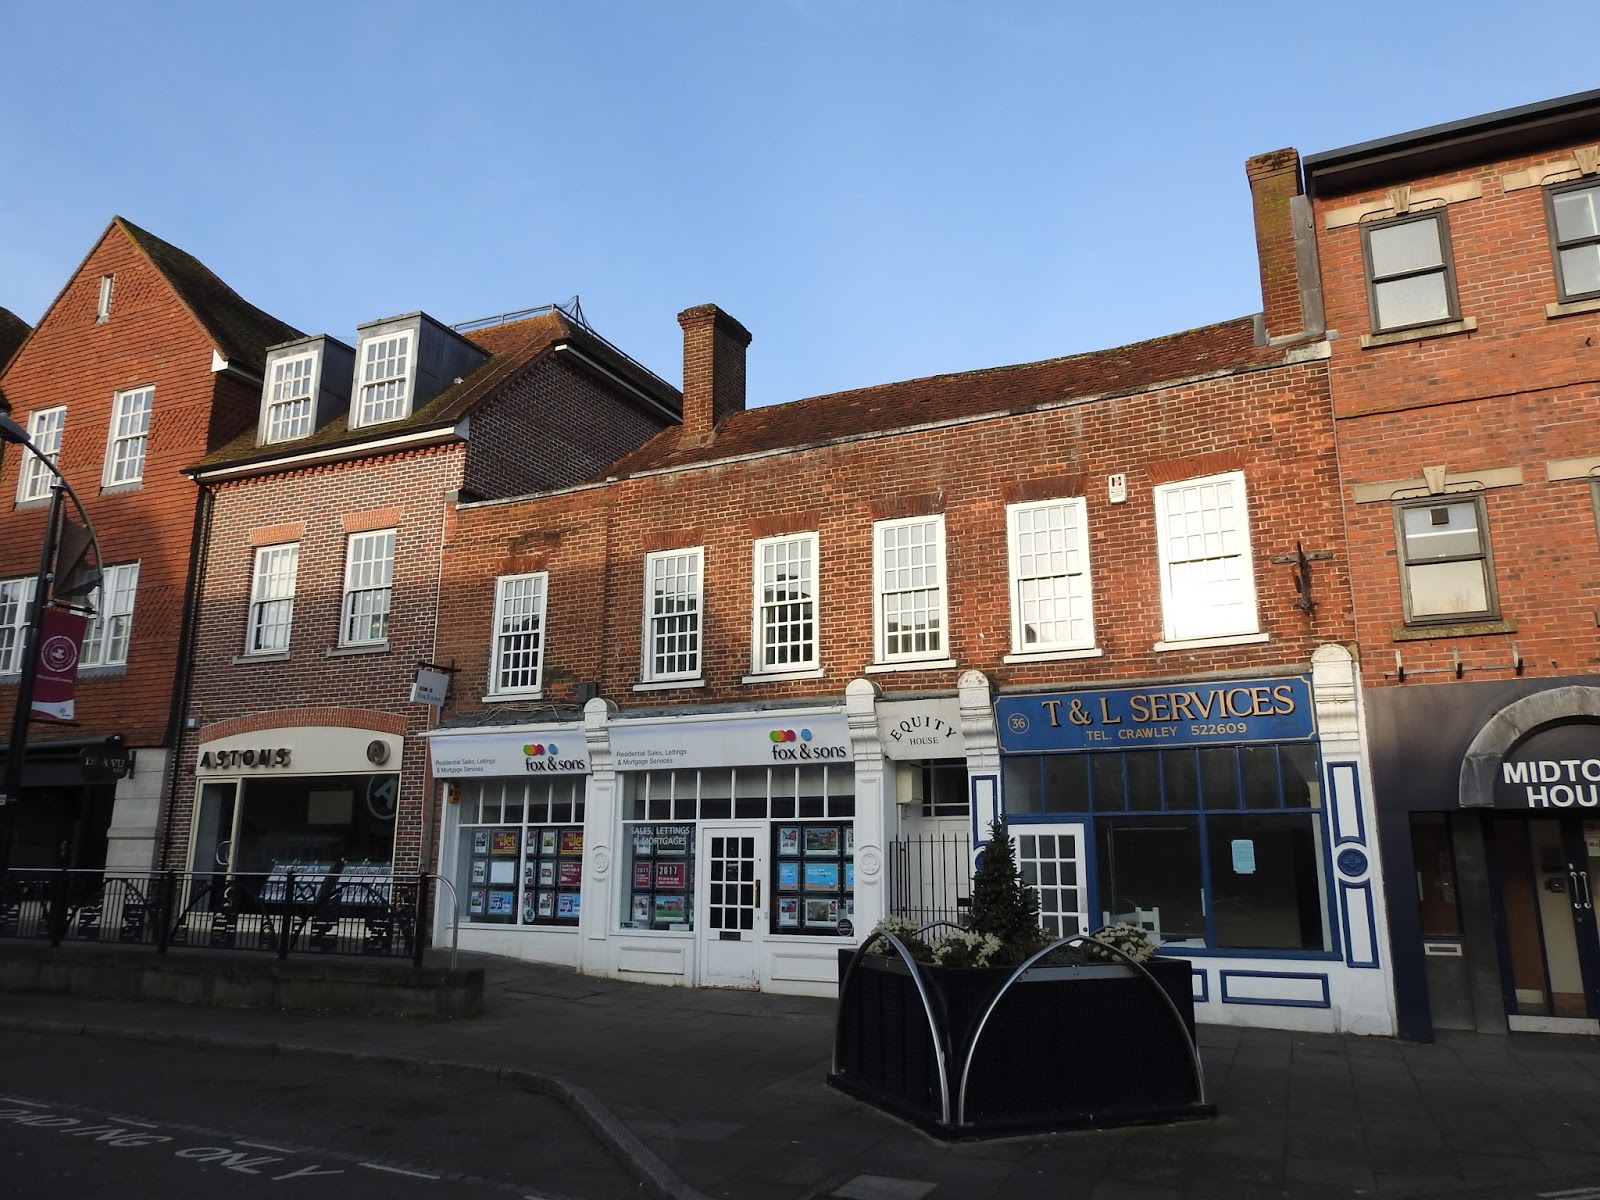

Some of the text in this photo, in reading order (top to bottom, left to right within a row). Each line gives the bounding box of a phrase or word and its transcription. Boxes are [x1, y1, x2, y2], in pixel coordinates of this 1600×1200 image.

[1042, 685, 1296, 727] T & L SERVICES
[890, 716, 957, 742] EQUITY
[1011, 718, 1026, 729] 36
[1086, 722, 1247, 741] TEL. CRAWLEY 522609
[909, 737, 939, 746] HOUSE
[200, 748, 291, 769] ASTONS
[647, 749, 664, 757] Sales,
[665, 748, 687, 757] Lettings
[771, 743, 847, 760] fox & sons
[111, 758, 125, 768] VU
[525, 756, 585, 771] fox & sons
[623, 758, 649, 766] Mortgage
[650, 757, 673, 765] Services
[1503, 759, 1600, 783] MIDTO
[1526, 784, 1598, 807] HOU
[631, 826, 690, 835] SALES, LETTINGS
[504, 833, 515, 846] let
[641, 837, 687, 845] MORTGAGES
[659, 866, 678, 875] 2017
[174, 1147, 345, 1181] ONLY
